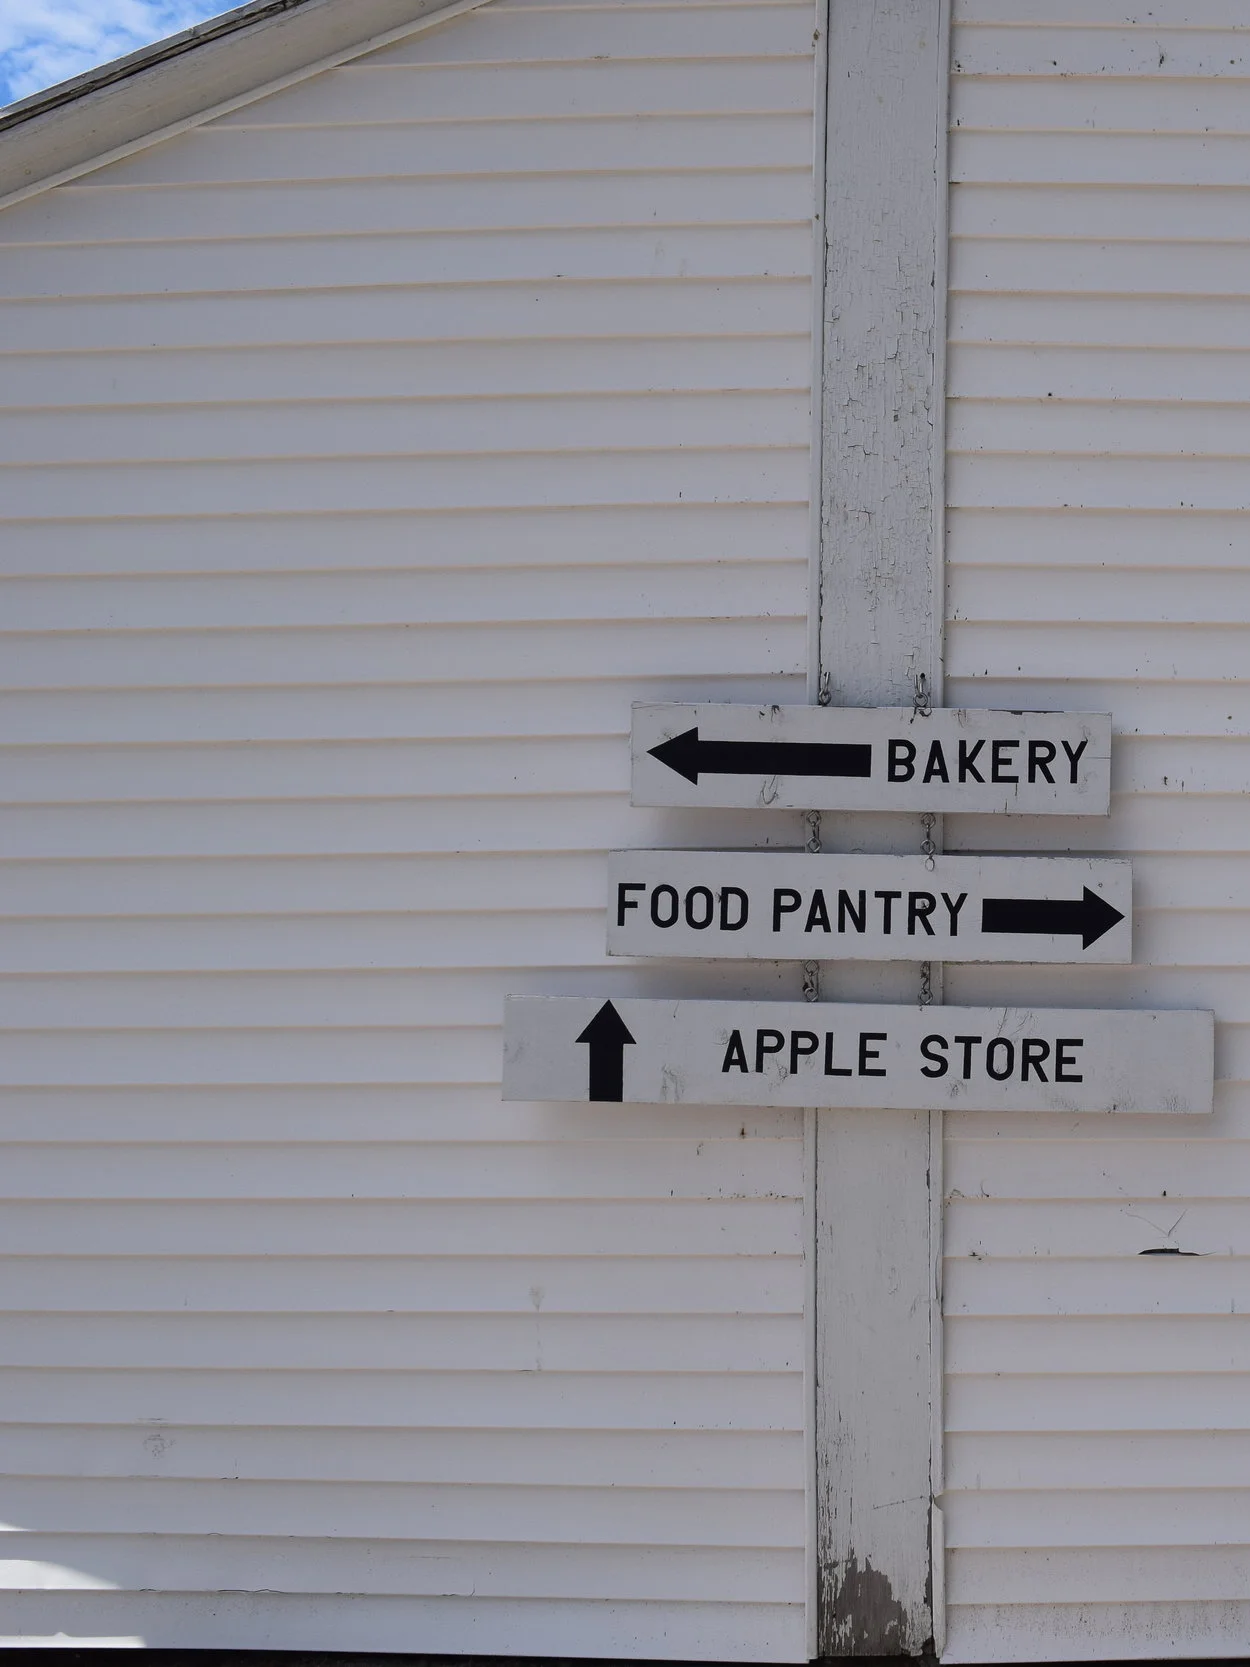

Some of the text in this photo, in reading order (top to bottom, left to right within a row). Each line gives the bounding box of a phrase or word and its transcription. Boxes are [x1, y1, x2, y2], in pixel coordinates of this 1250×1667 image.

[888, 739, 1088, 783] BAKERY
[618, 883, 967, 936] FOOD PANTRY
[722, 1029, 1083, 1082] APPLE STORE
